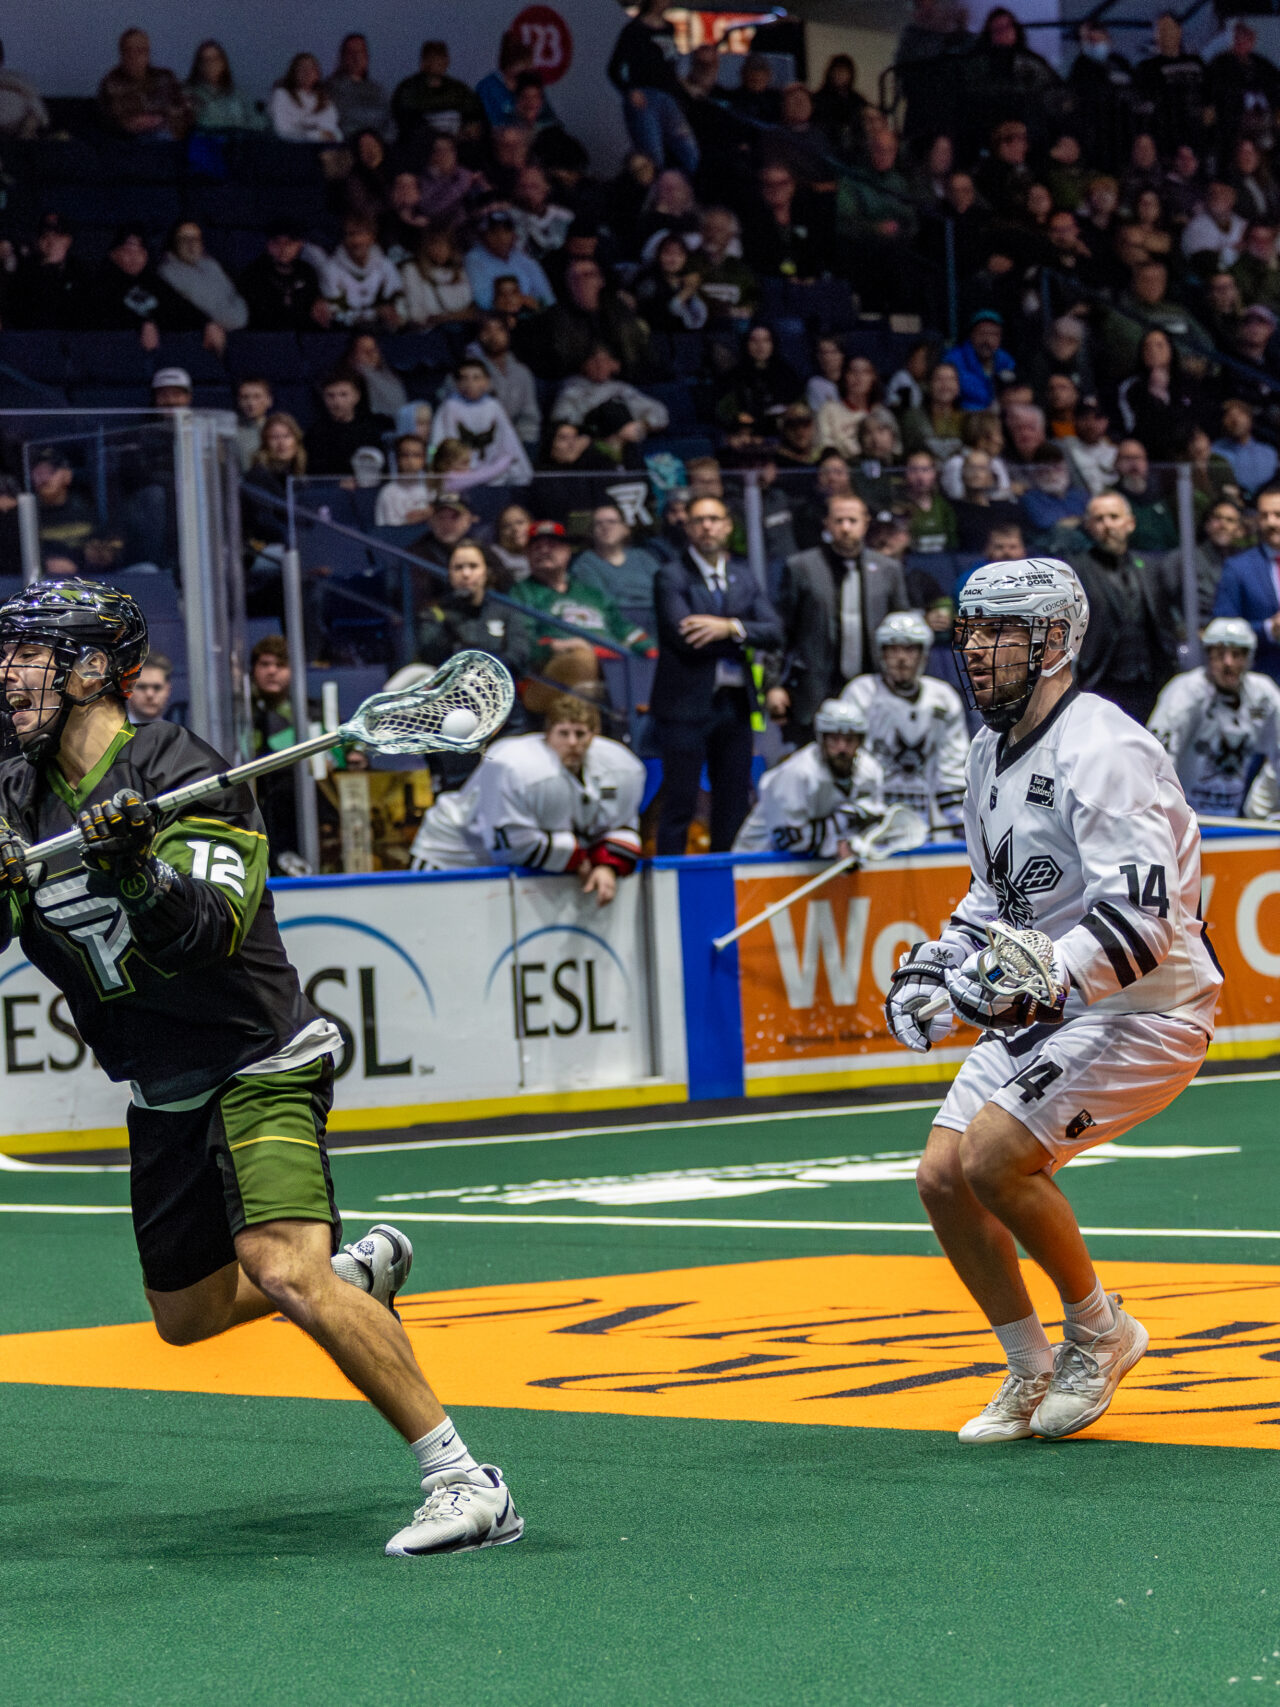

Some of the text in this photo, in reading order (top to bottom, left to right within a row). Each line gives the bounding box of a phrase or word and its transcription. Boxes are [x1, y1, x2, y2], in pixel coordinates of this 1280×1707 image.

[186, 840, 246, 898] 12
[1119, 864, 1170, 919] 14
[2, 992, 102, 1075] ES
[304, 966, 413, 1082] SL
[511, 958, 617, 1040] ESL
